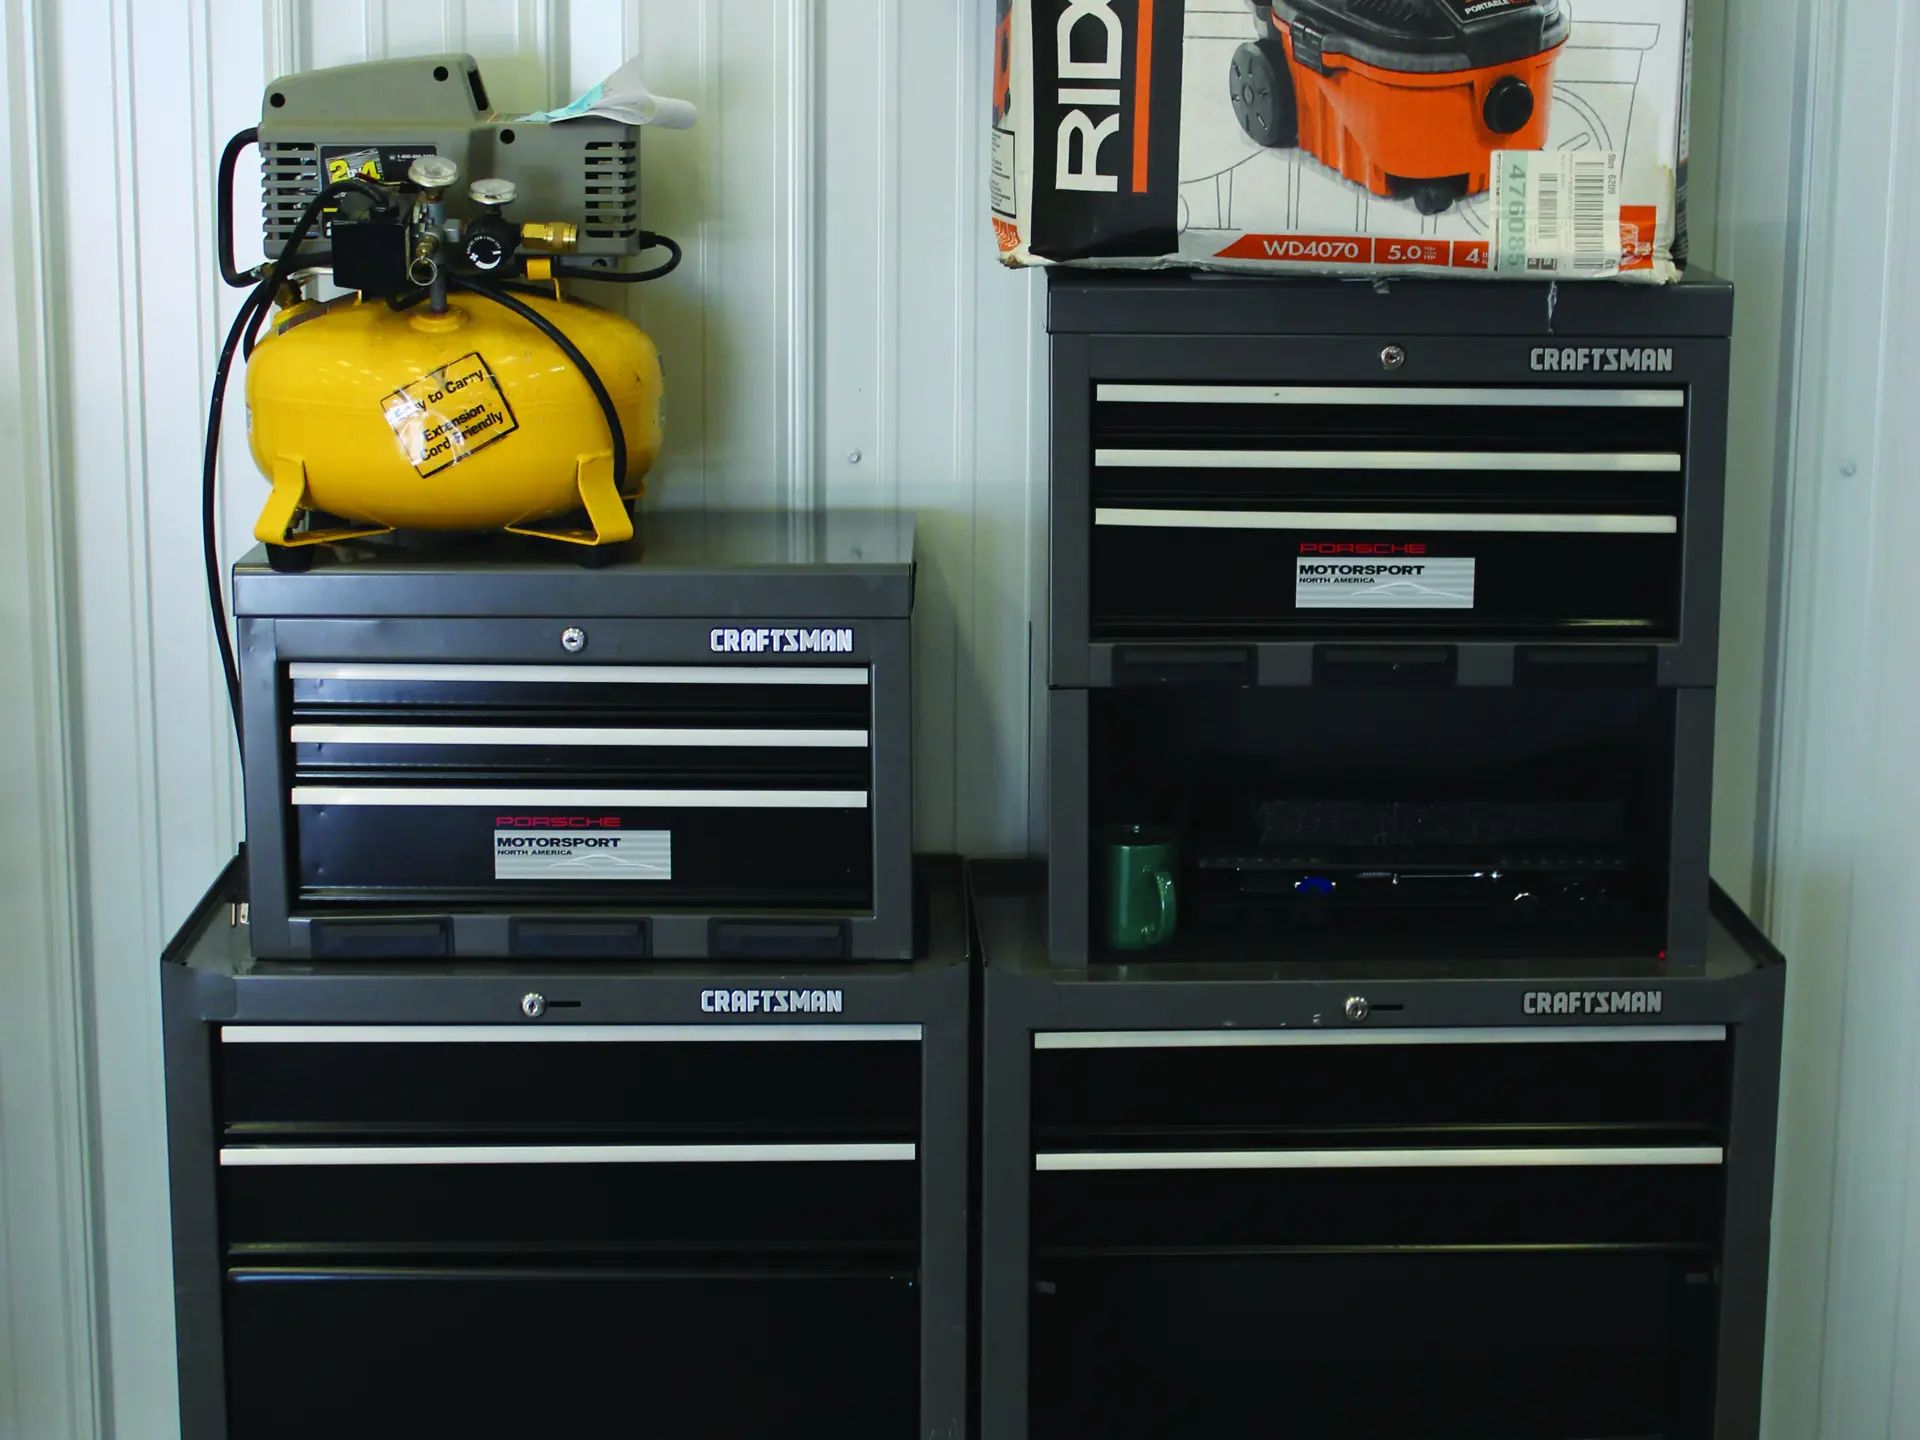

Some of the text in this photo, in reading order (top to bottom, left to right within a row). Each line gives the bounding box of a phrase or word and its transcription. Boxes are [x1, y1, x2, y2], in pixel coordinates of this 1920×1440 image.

[1055, 0, 1123, 192] RID
[329, 159, 350, 183] 2
[1607, 174, 1617, 195] 6209
[1507, 163, 1527, 267] 476085
[1263, 240, 1360, 258] WD4070
[1387, 244, 1422, 261] 5.0
[1464, 247, 1480, 264] 4
[1530, 347, 1673, 371] CRAFTSMAN
[393, 368, 484, 419] Ey to Carry
[423, 403, 486, 442] Extension
[420, 411, 504, 461] Cord Friendly
[1299, 543, 1427, 554] PORSCHE
[1299, 564, 1425, 575] MOTORSPORT
[1333, 576, 1376, 584] AMERICA
[709, 628, 853, 652] CRAFTSMAN
[496, 816, 621, 827] PORSCHE
[497, 837, 621, 848] MOTORSPORT
[700, 989, 843, 1012] CRAFTSMAN
[1523, 991, 1662, 1014] CRAFTSMAN
